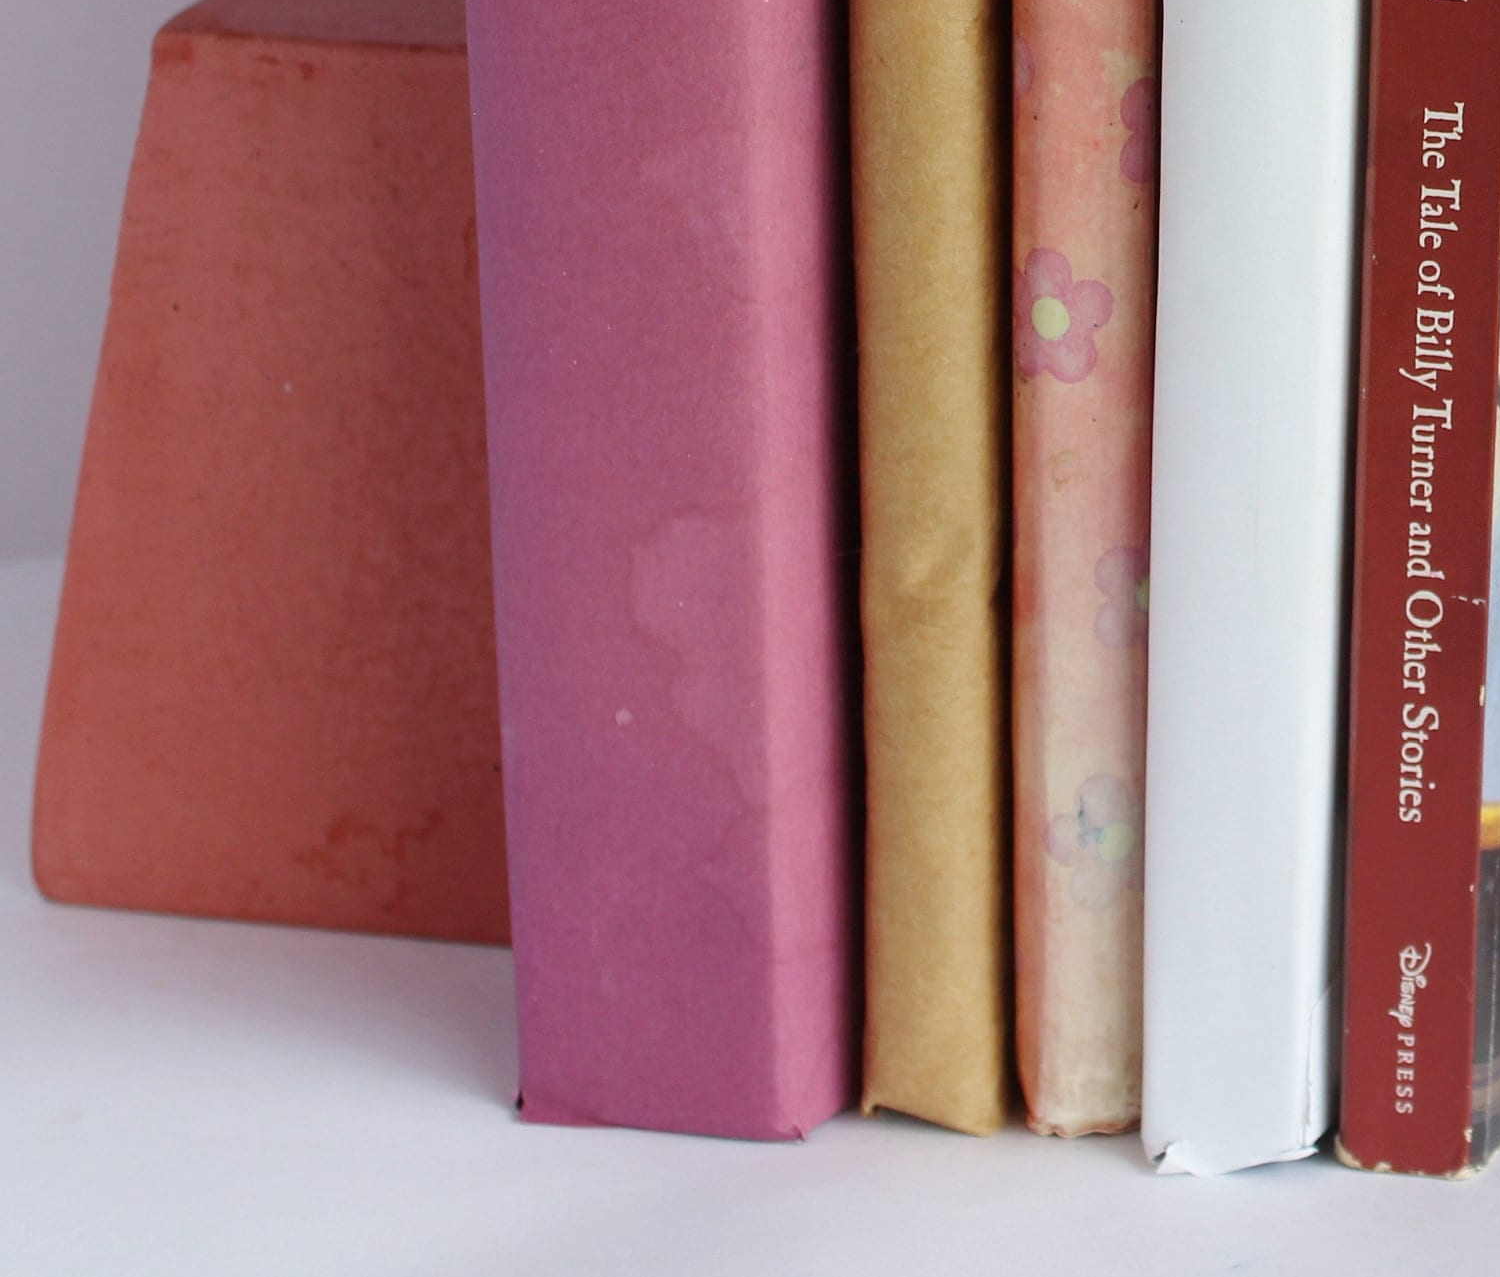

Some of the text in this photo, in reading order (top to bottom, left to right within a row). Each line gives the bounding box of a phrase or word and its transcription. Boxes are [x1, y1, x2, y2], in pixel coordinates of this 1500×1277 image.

[1398, 102, 1465, 823] The Tale of Billy Turner and Other Stories
[1388, 942, 1432, 1114] Disney PRESS
